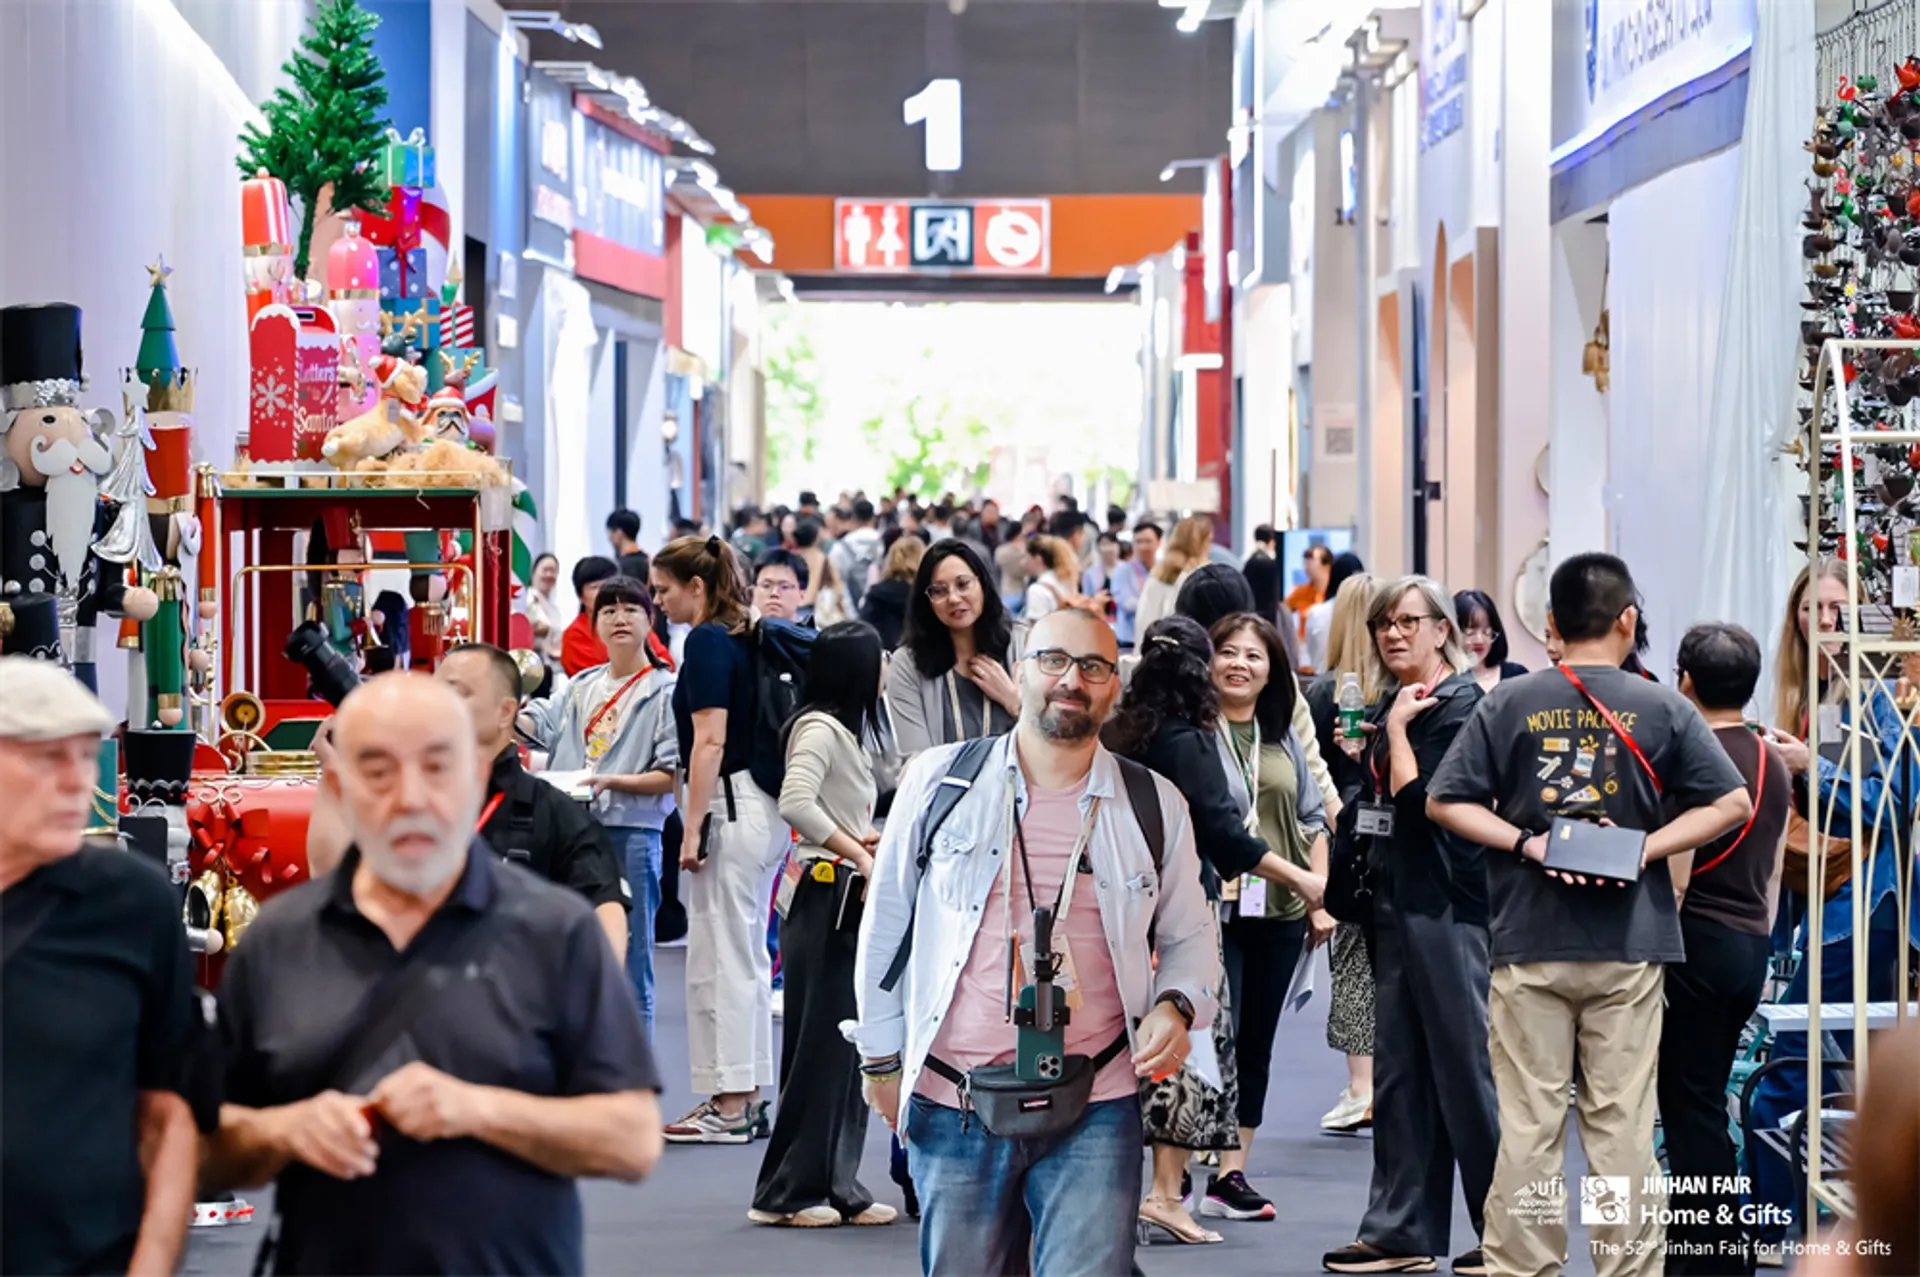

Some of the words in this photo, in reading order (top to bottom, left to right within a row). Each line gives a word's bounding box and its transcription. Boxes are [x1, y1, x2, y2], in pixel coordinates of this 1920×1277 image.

[903, 78, 961, 170] 1
[298, 407, 335, 433] Santa
[1526, 709, 1572, 733] MOVIE
